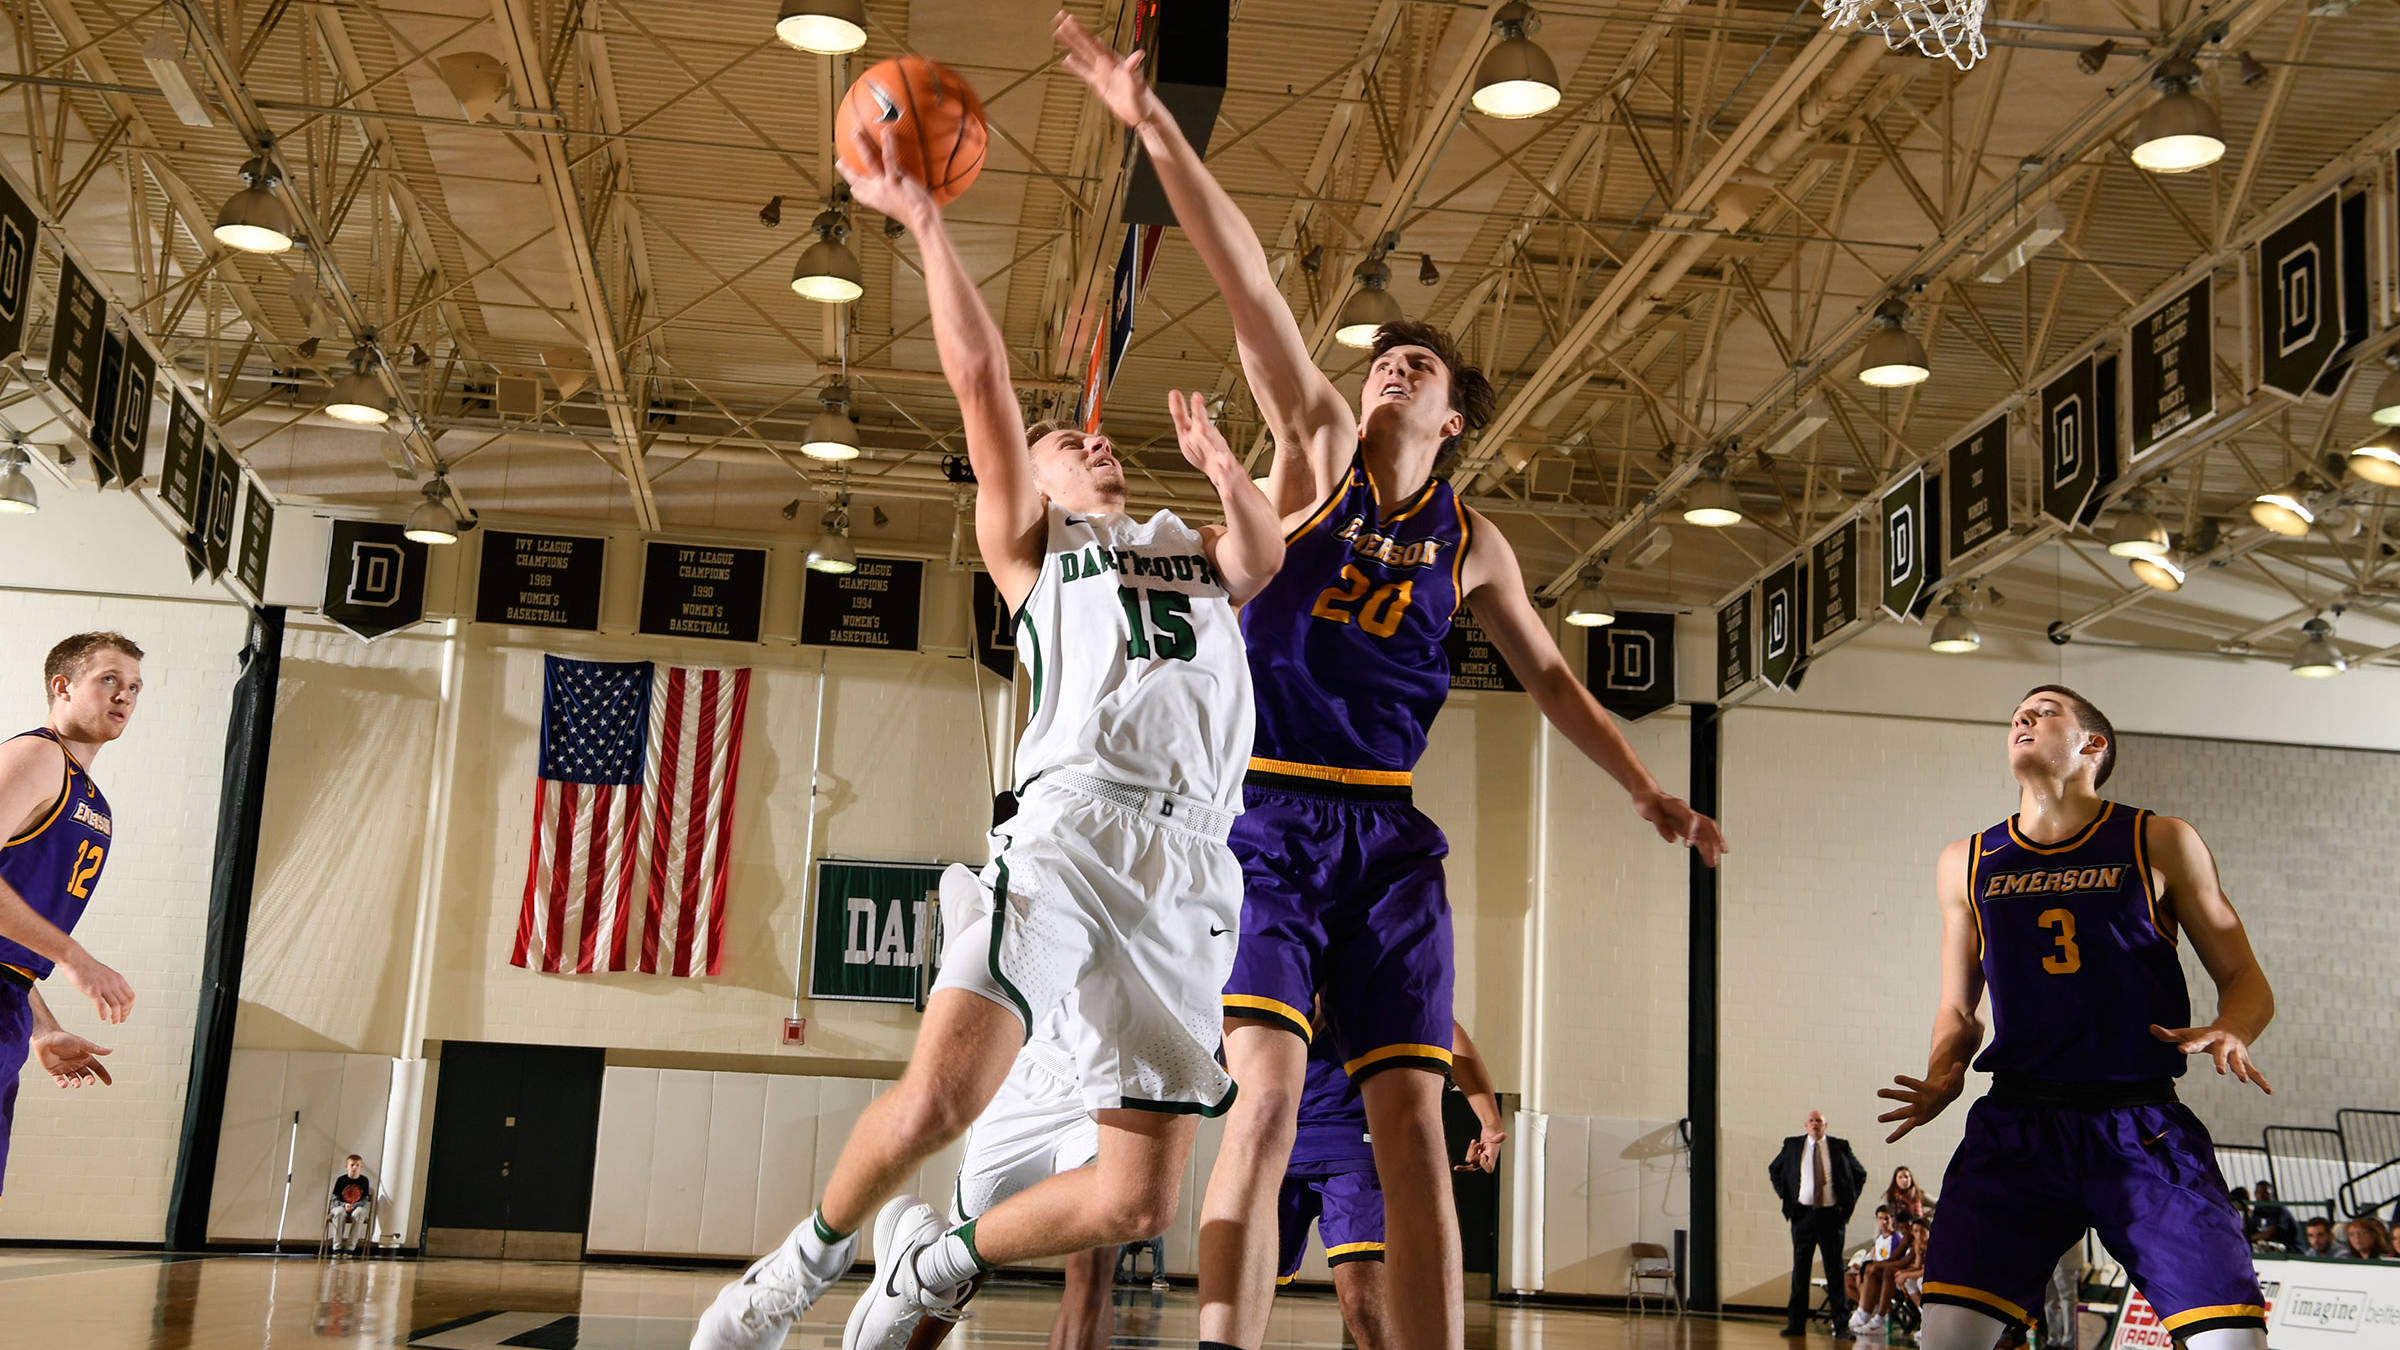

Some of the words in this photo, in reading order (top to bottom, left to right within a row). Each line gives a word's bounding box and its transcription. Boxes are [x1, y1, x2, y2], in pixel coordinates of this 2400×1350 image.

[2278, 241, 2321, 358] D
[121, 361, 146, 452] D
[2054, 393, 2082, 490] D
[213, 470, 232, 548] D
[515, 538, 533, 551] IVY
[537, 541, 573, 554] LEAGUE
[1891, 504, 1913, 588] D
[516, 554, 569, 569] CHAMPIONS
[679, 550, 695, 562] IVY
[700, 552, 734, 565] LEAGUE
[346, 541, 405, 607] D
[679, 565, 730, 580] CHAMPIONS
[858, 563, 892, 577] LEAGUE
[529, 573, 552, 587] 1989
[838, 577, 888, 592] CHAMPIONS
[519, 592, 560, 606] WOMEN'S
[692, 585, 714, 598] 1990
[851, 597, 873, 609] 1994
[1311, 563, 1414, 639] 20
[506, 607, 568, 623] BASKETBALL
[682, 603, 724, 617] WOMEN'S
[669, 618, 730, 635] BASKETBALL
[842, 615, 880, 629] WOMEN'S
[1117, 584, 1198, 662] 15
[1768, 588, 1788, 660] D
[829, 629, 889, 645] BASKETBALL
[1468, 646, 1488, 659] 2000
[1607, 629, 1655, 691] D
[1460, 662, 1497, 675] WOMEN'S
[1450, 674, 1504, 689] BASKETBALL
[1984, 866, 2122, 898] EMERSON
[2038, 908, 2081, 975] 3
[2292, 1294, 2358, 1325] imagine
[2125, 1329, 2172, 1348] RADIO
